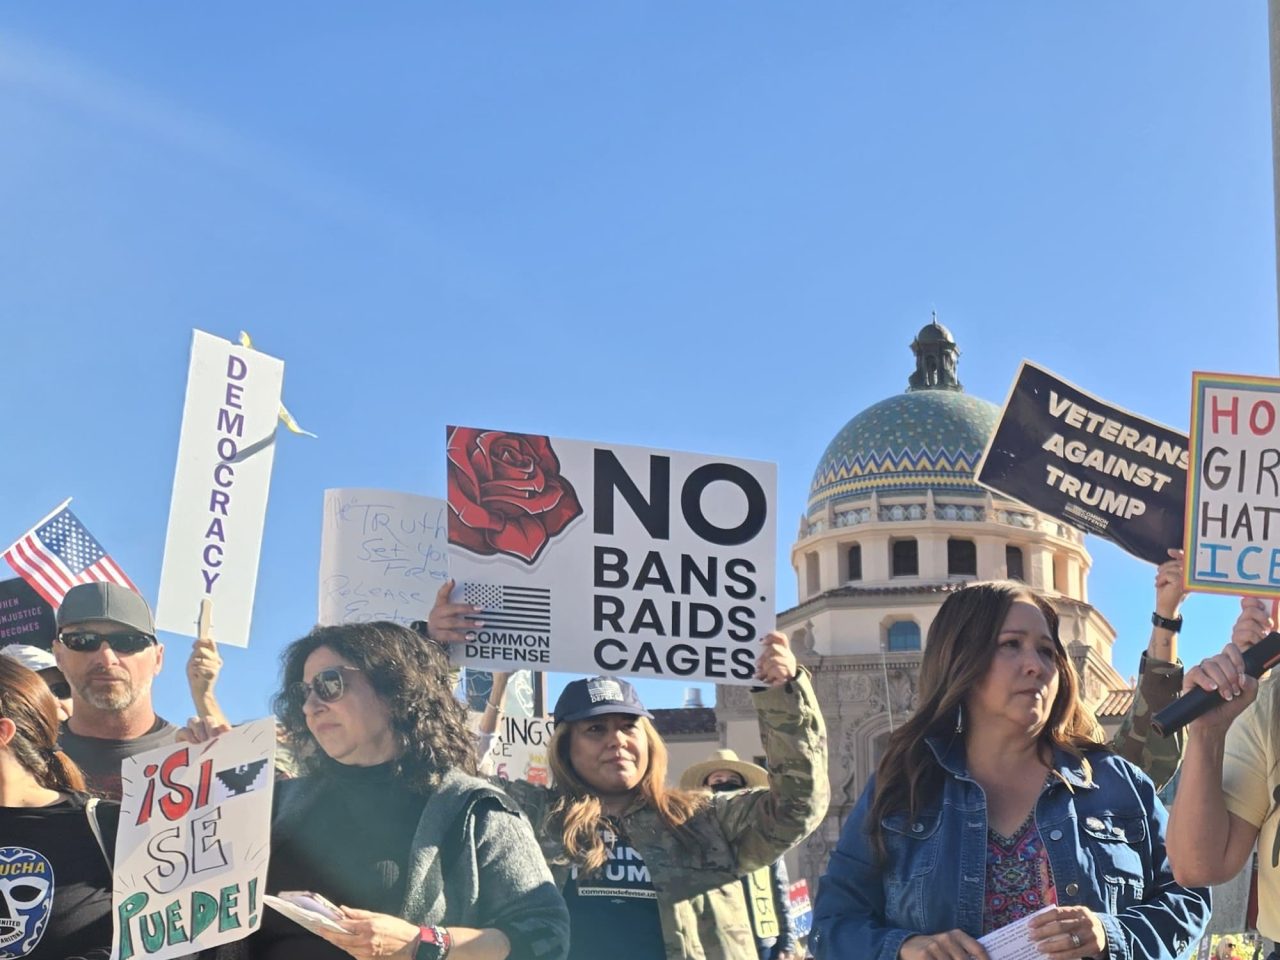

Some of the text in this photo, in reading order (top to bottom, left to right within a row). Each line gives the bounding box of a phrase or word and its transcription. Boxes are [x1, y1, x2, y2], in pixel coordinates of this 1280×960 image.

[1048, 390, 1189, 470] VETERANS
[201, 354, 248, 595] DEMOCRACY
[1042, 433, 1172, 493] AGAINST
[593, 448, 767, 546] NO
[1046, 464, 1146, 520] TRUMP
[593, 545, 767, 602] BANS.
[465, 630, 550, 648] COMMON
[465, 645, 550, 663] DEFENSE
[593, 638, 756, 680] CAGES
[0, 862, 46, 876] UCHA
[144, 806, 228, 894] SE
